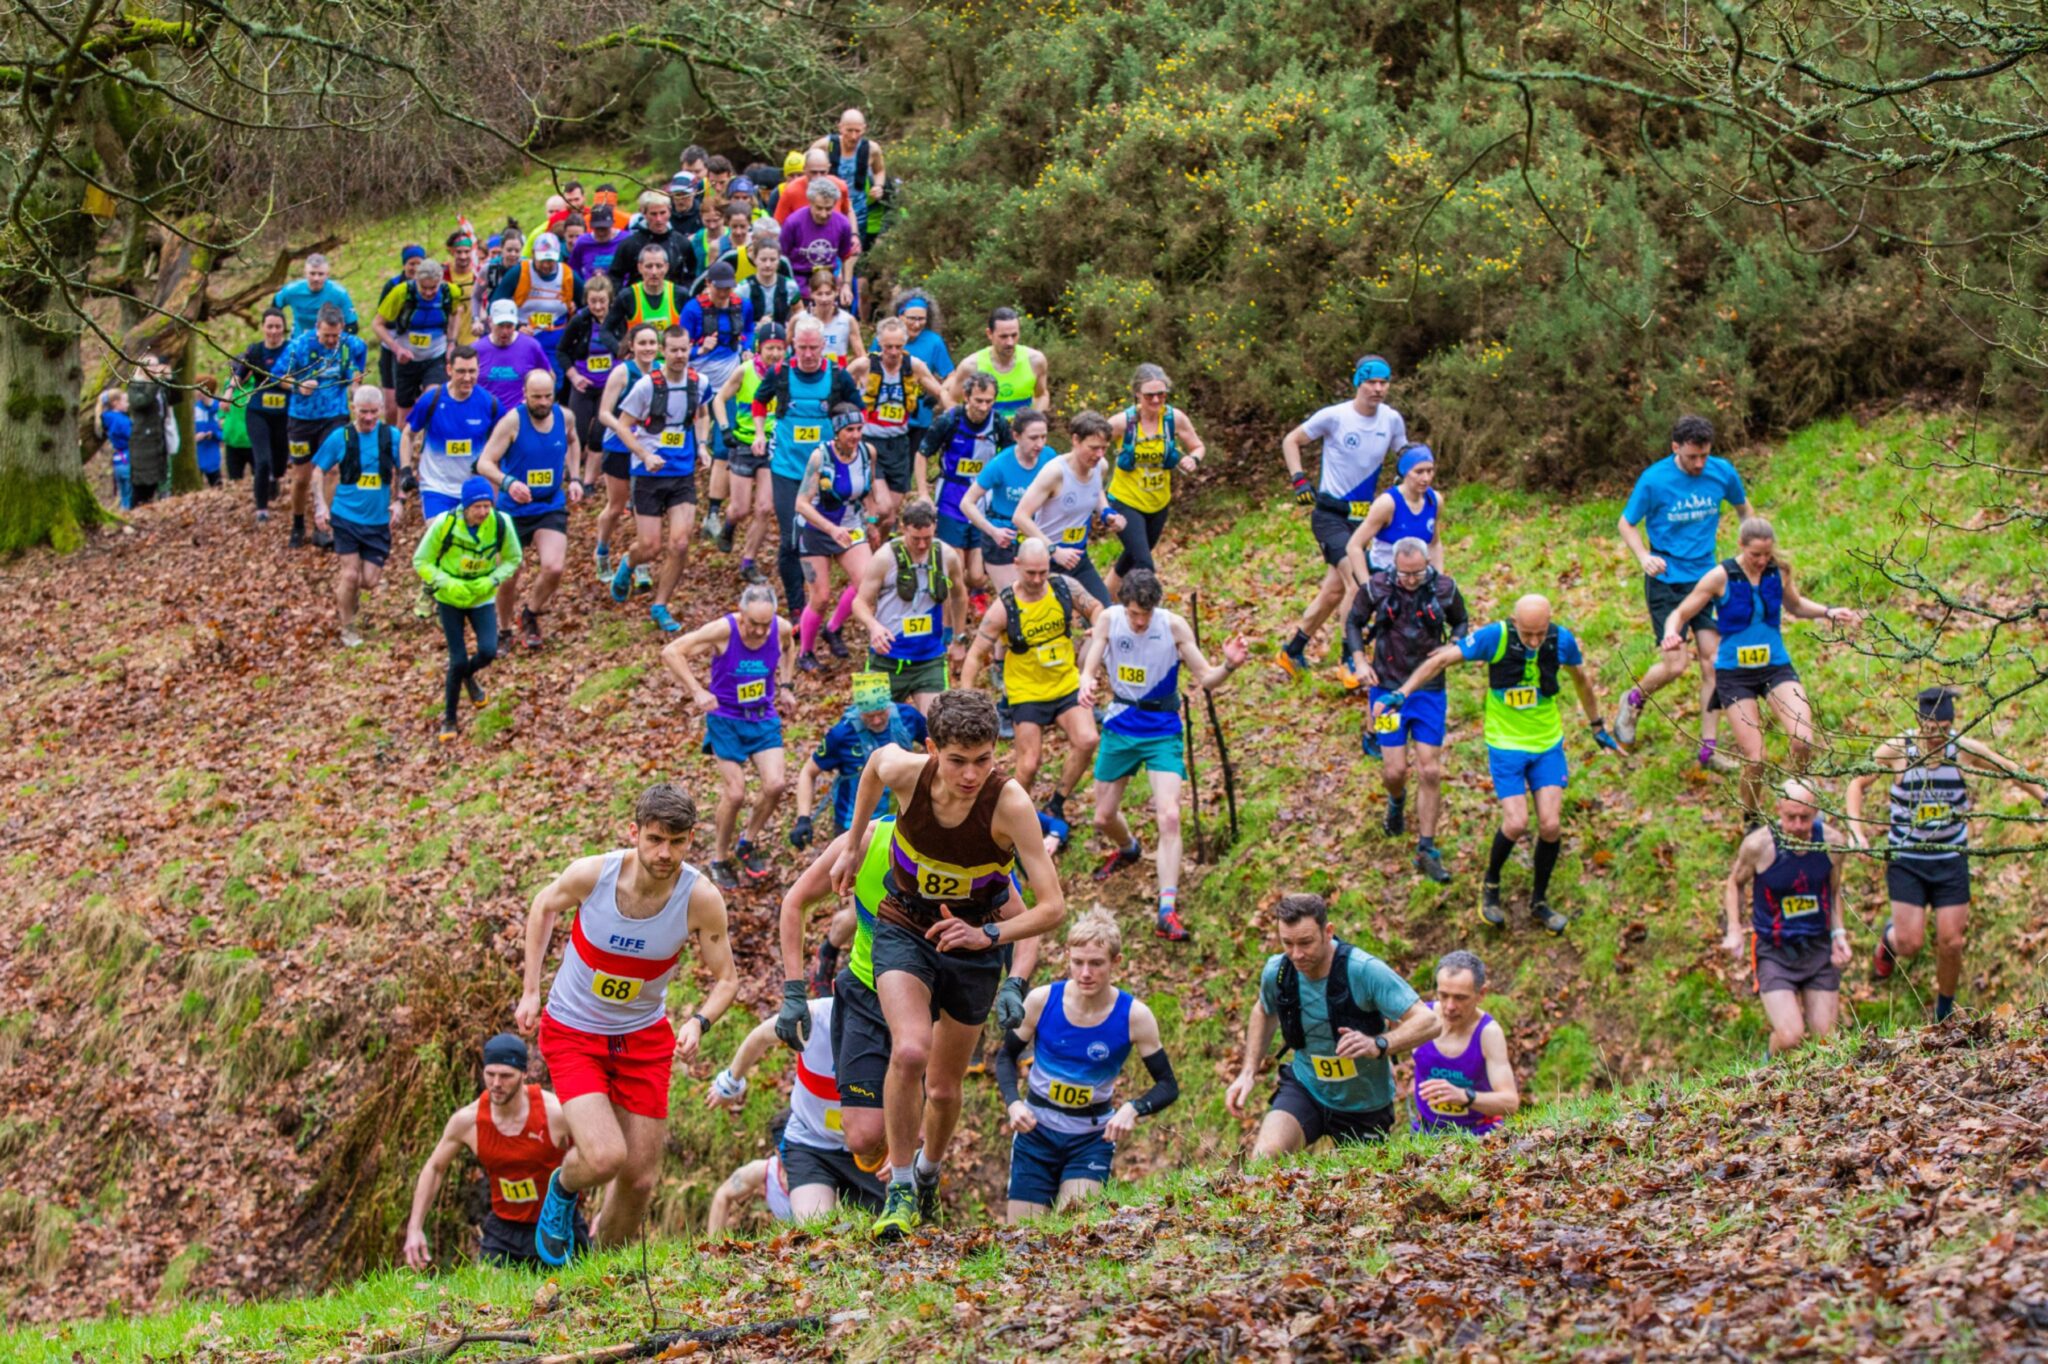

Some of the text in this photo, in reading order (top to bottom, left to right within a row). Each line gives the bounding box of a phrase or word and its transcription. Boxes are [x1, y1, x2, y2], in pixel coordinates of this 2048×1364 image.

[412, 335, 427, 346] 37
[590, 357, 610, 369] 132
[883, 405, 902, 419] 151
[666, 433, 681, 445] 98
[800, 428, 815, 439] 24
[451, 442, 466, 453] 64
[961, 460, 983, 474] 120
[362, 476, 376, 486] 74
[530, 472, 551, 483] 139
[1068, 528, 1082, 540] 47
[909, 617, 925, 632] 57
[1049, 647, 1056, 659] 4
[1742, 648, 1767, 663] 147
[1120, 667, 1145, 683] 138
[740, 682, 763, 699] 152
[1507, 689, 1534, 704] 117
[923, 872, 959, 895] 82
[608, 934, 646, 950] FIFE
[599, 978, 630, 999] 68
[1318, 1059, 1343, 1078] 91
[1431, 1068, 1464, 1079] OCHIL
[1053, 1083, 1090, 1105] 105
[505, 1181, 531, 1200] 111
